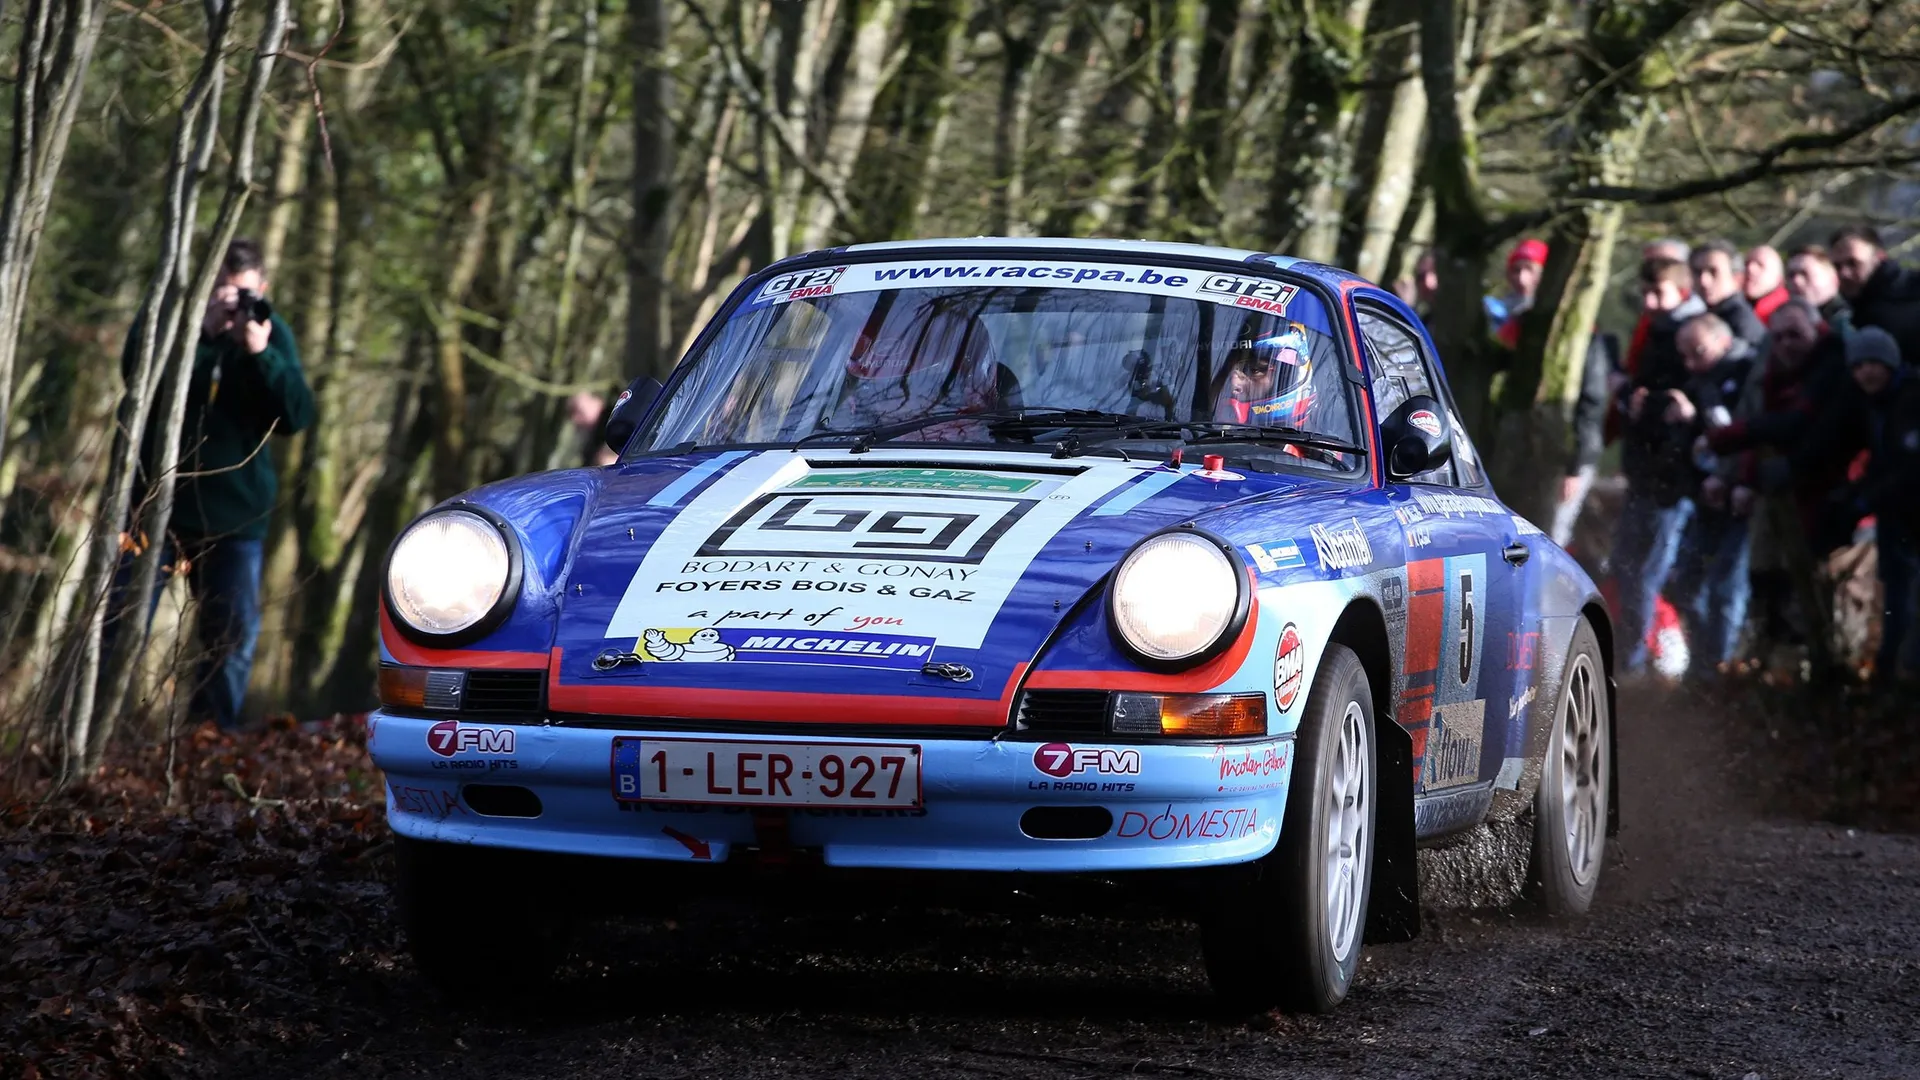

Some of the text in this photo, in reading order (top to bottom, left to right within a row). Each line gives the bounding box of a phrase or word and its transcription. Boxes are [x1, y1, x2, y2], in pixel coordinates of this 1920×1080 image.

[764, 267, 846, 295] GT2i
[874, 265, 1189, 288] www.racspa.be
[1204, 275, 1294, 304] GT2i
[788, 284, 834, 300] BMA
[1236, 295, 1284, 314] BMA
[680, 560, 979, 582] BODART & GONAY
[655, 579, 977, 602] FOYERS BOIS & GAZ
[687, 606, 905, 632] a part of you
[1460, 573, 1476, 684] 5
[741, 635, 932, 658] MICHELIN
[1275, 643, 1304, 690] BMA
[428, 721, 516, 758] 7FM
[431, 759, 519, 770] LA RADIO HITS
[1033, 742, 1141, 779] 7FM
[619, 749, 907, 799] B 1-LER-927
[1028, 781, 1136, 792] LA RADIO HITS
[1116, 804, 1258, 840] DOMESTIA
